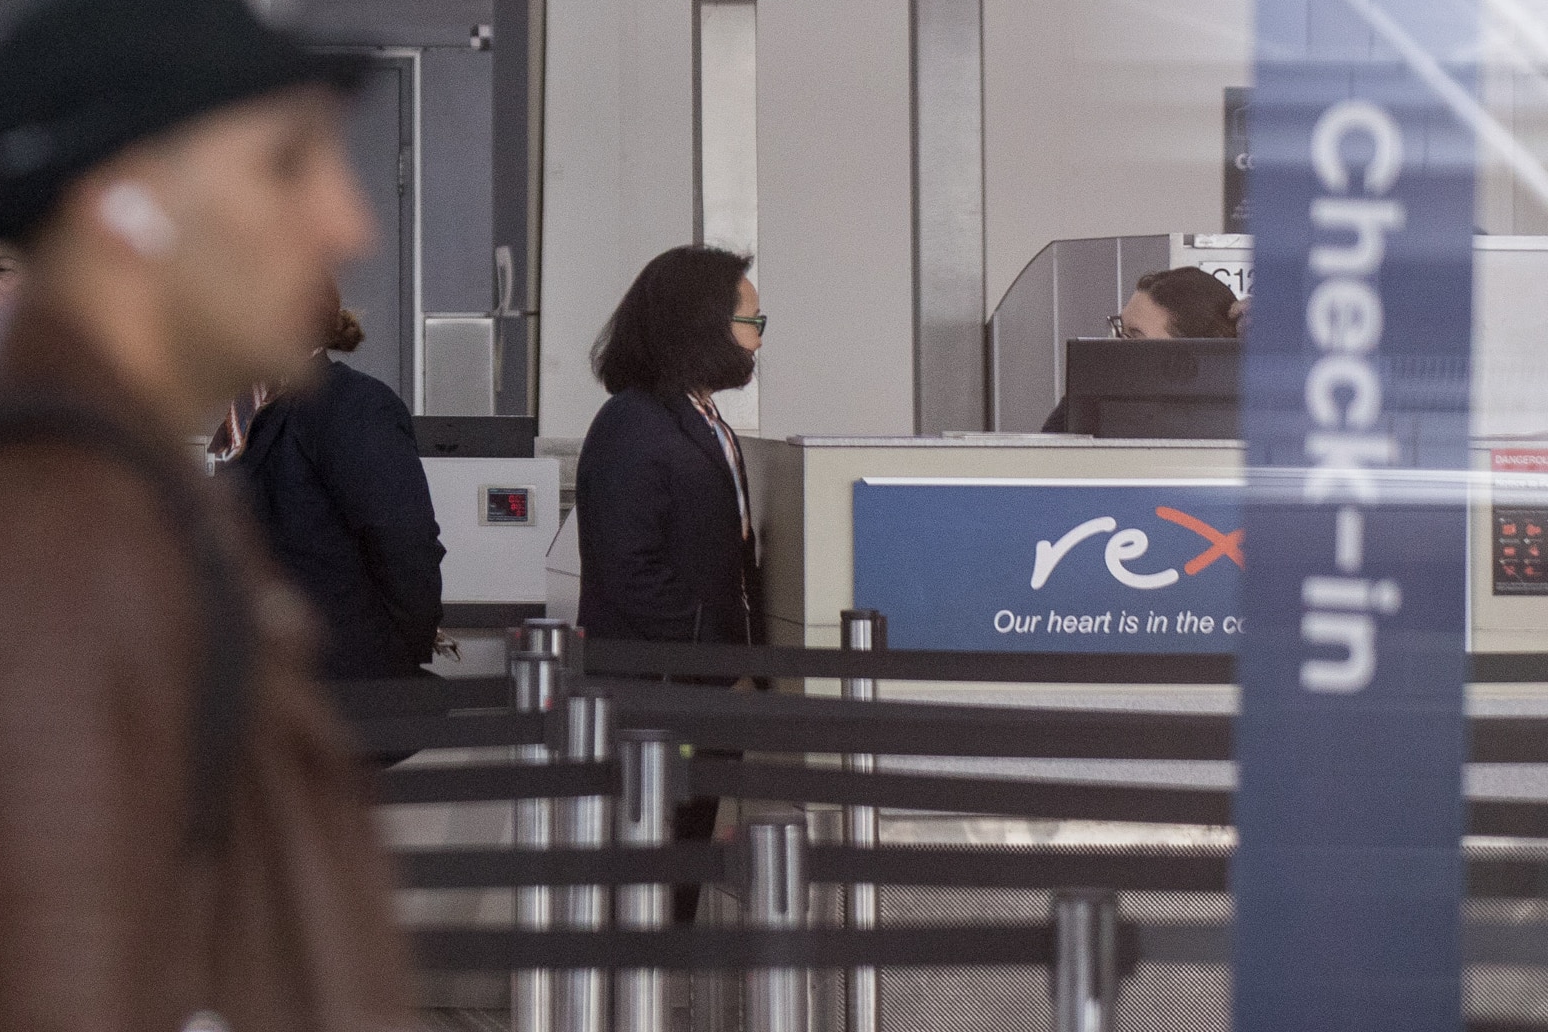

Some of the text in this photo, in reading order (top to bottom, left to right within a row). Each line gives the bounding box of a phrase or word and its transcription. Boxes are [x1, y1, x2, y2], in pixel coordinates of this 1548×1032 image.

[1300, 98, 1406, 694] Check-in
[1495, 454, 1548, 465] DANGEROU
[1030, 506, 1246, 590] rex
[993, 610, 1042, 634] Our
[1047, 610, 1112, 634] heart
[1118, 610, 1140, 634] is
[1146, 610, 1169, 634] in
[1176, 610, 1215, 634] the
